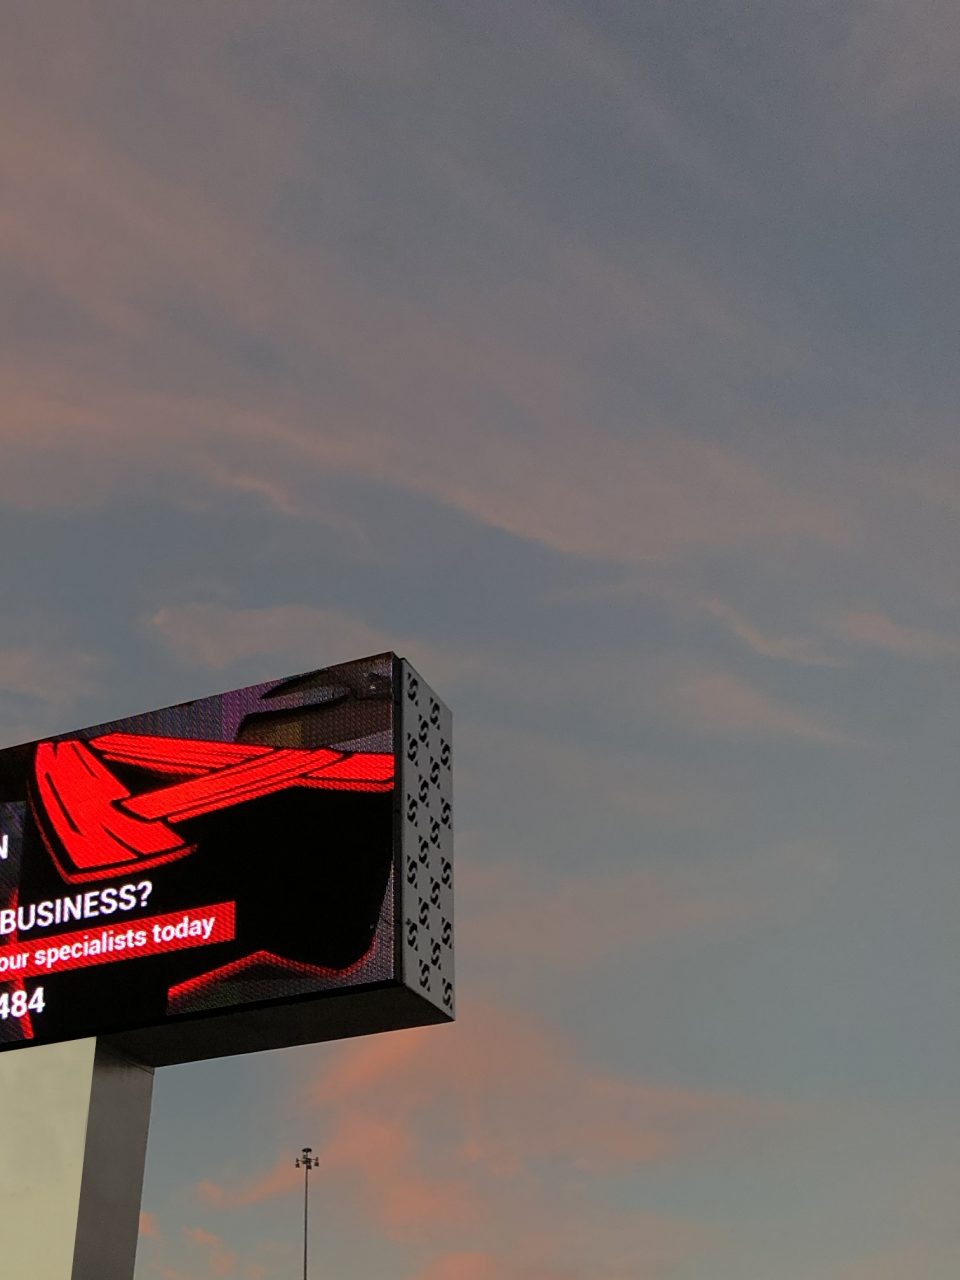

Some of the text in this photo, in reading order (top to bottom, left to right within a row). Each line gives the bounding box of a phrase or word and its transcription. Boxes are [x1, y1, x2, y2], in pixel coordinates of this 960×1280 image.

[0, 880, 153, 935] BUSINESS?
[33, 931, 147, 968] specialists
[151, 915, 216, 943] today
